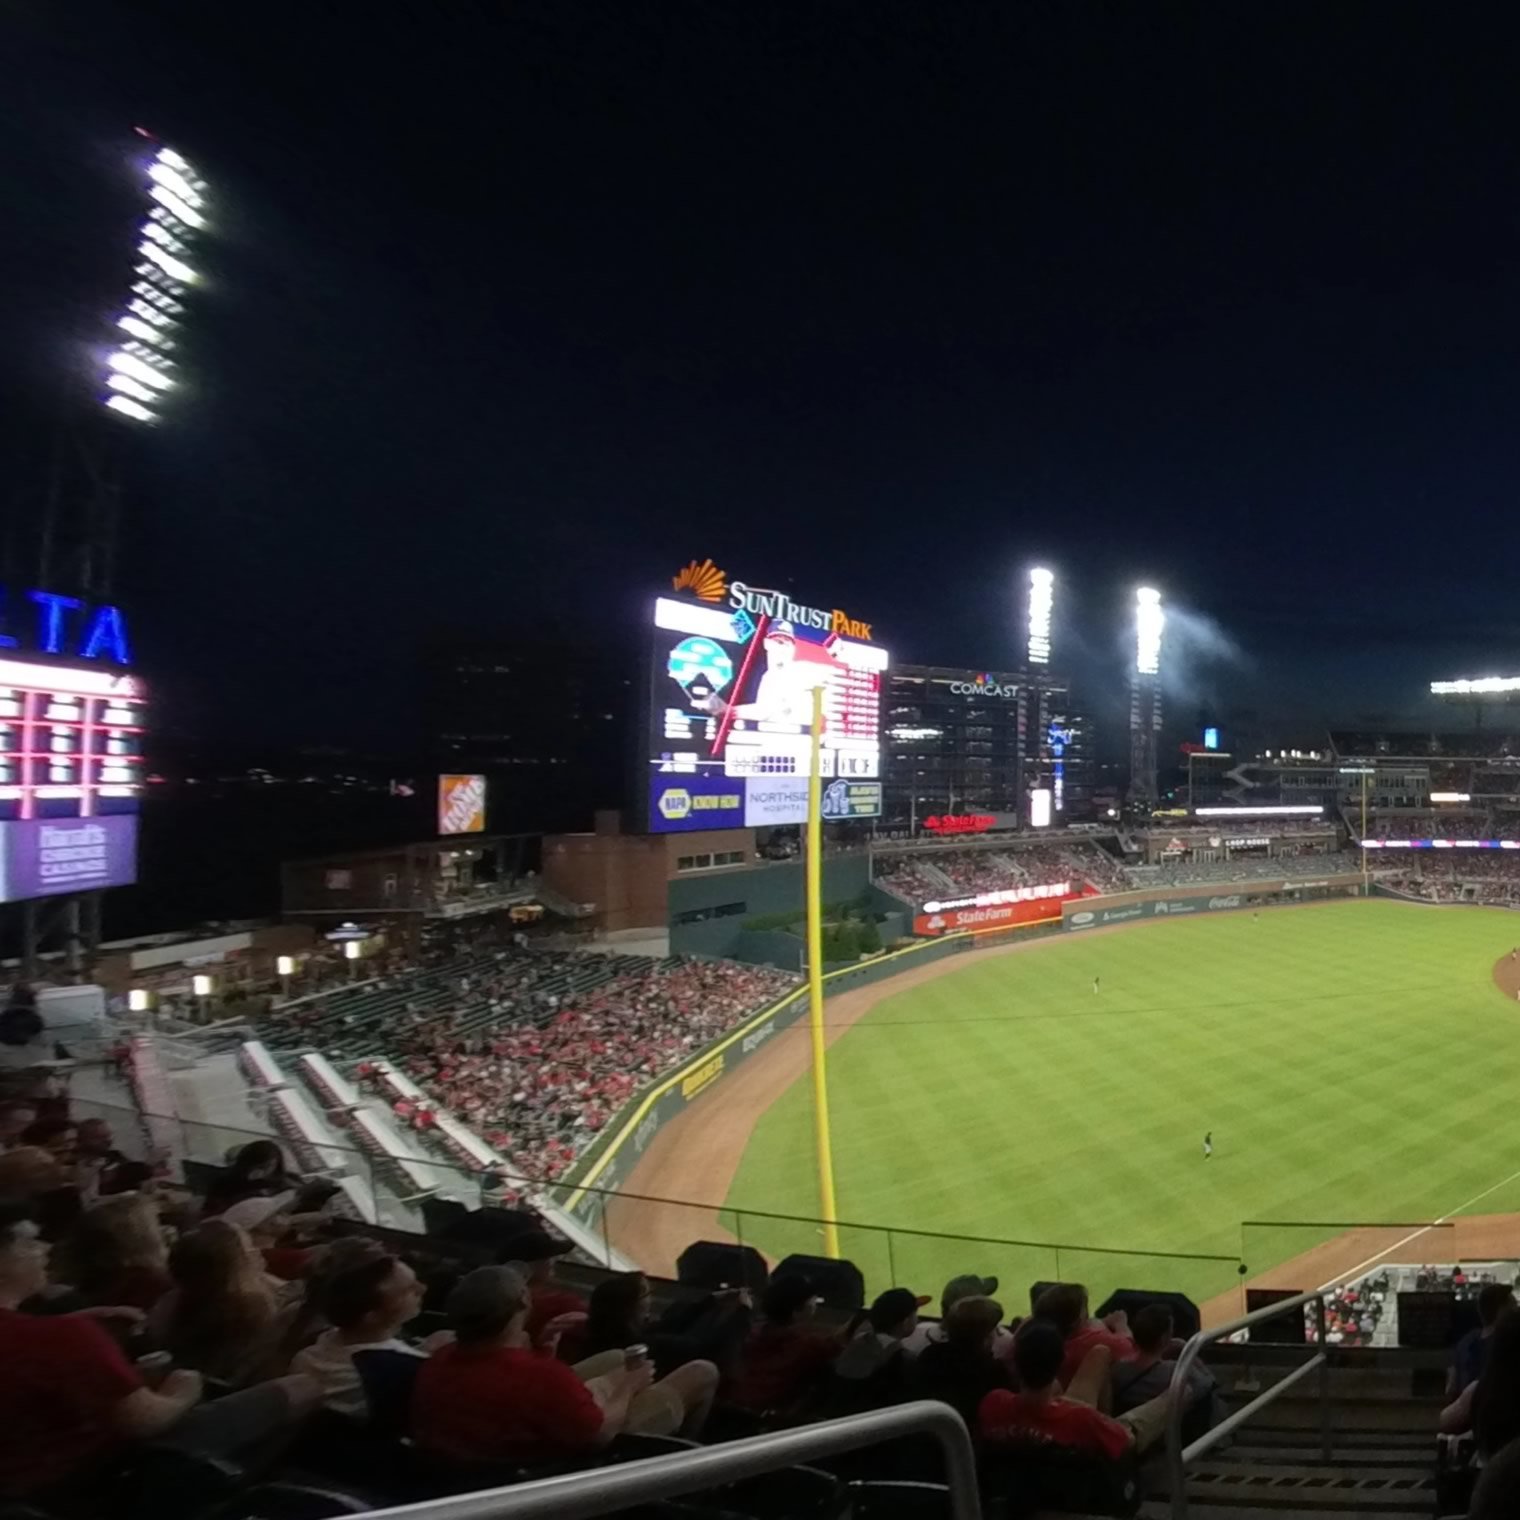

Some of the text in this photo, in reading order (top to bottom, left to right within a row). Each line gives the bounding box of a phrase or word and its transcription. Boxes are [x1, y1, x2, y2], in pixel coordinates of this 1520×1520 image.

[950, 683, 1019, 697] COMCAST
[665, 797, 687, 810] NAPA
[750, 791, 809, 803] NORTHSID
